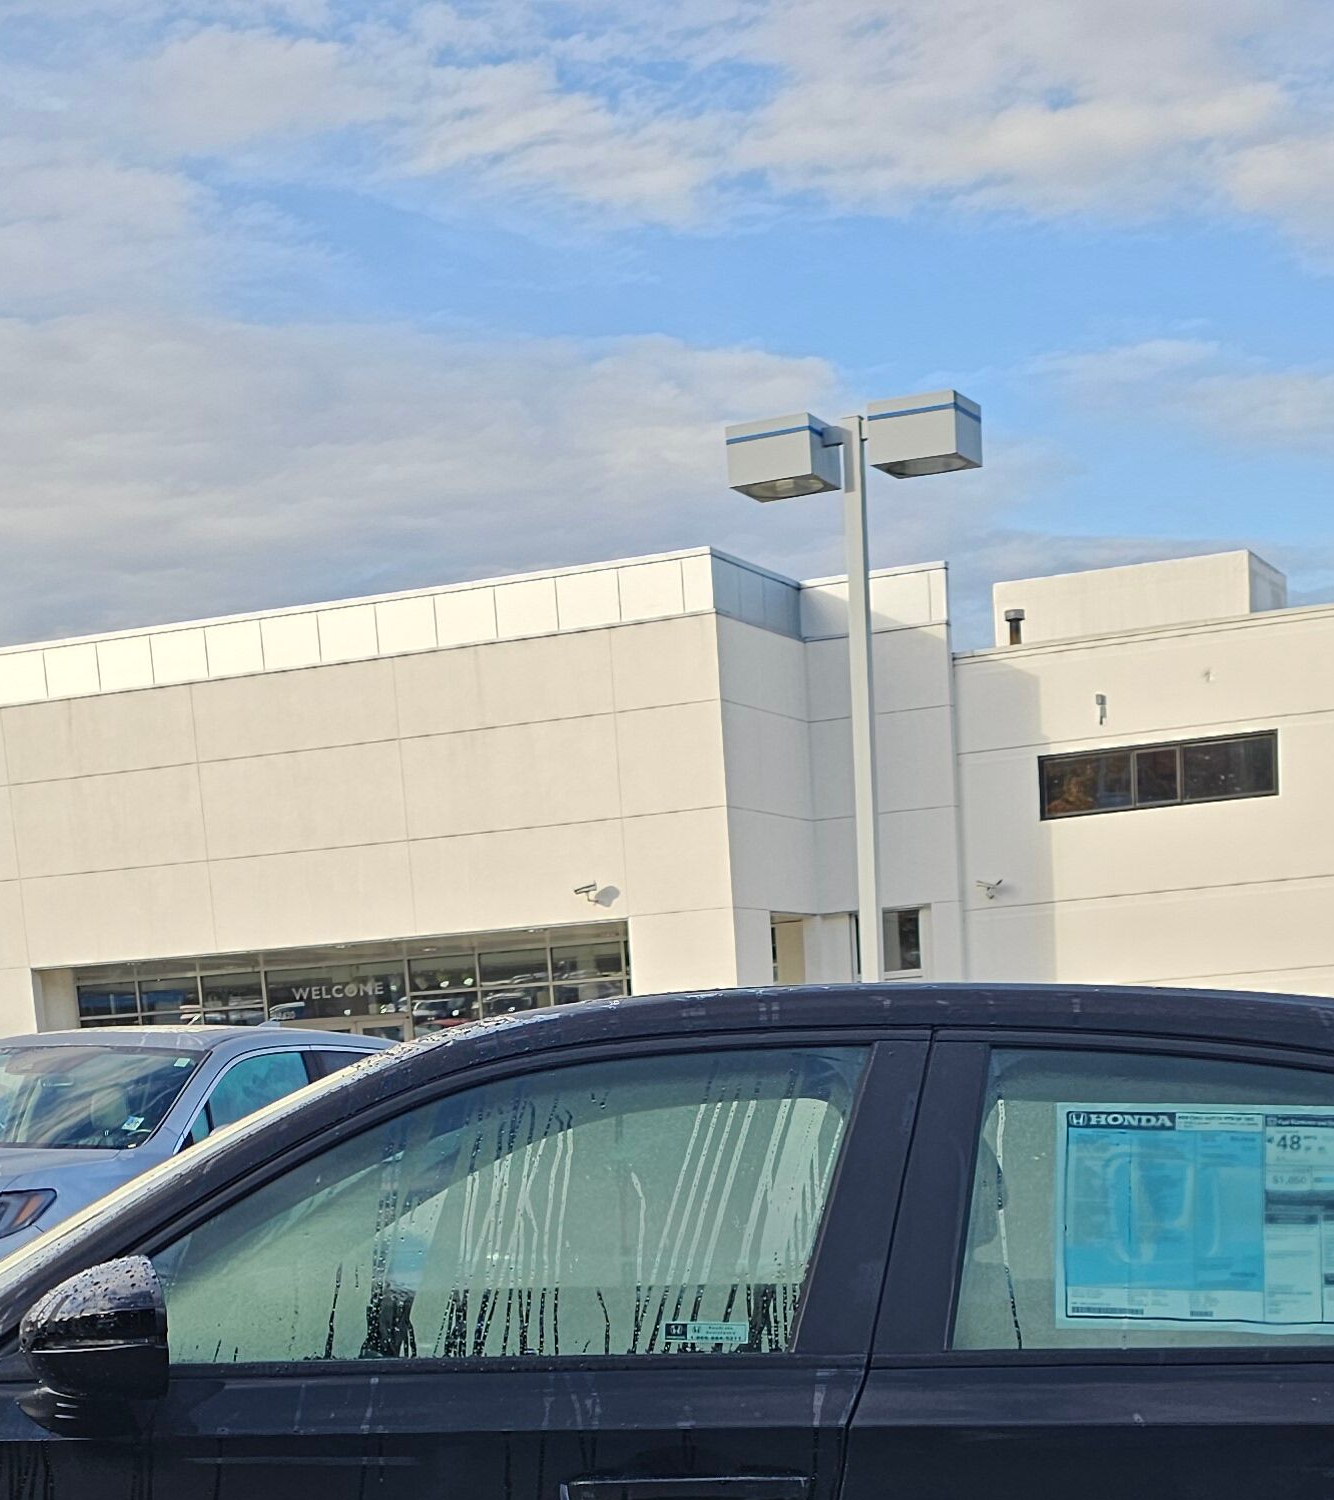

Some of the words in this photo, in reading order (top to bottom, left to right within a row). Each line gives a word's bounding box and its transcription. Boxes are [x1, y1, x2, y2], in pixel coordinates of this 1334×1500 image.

[291, 982, 385, 1000] WELCOME
[1089, 1113, 1173, 1127] HONDA
[1276, 1135, 1302, 1151] 48
